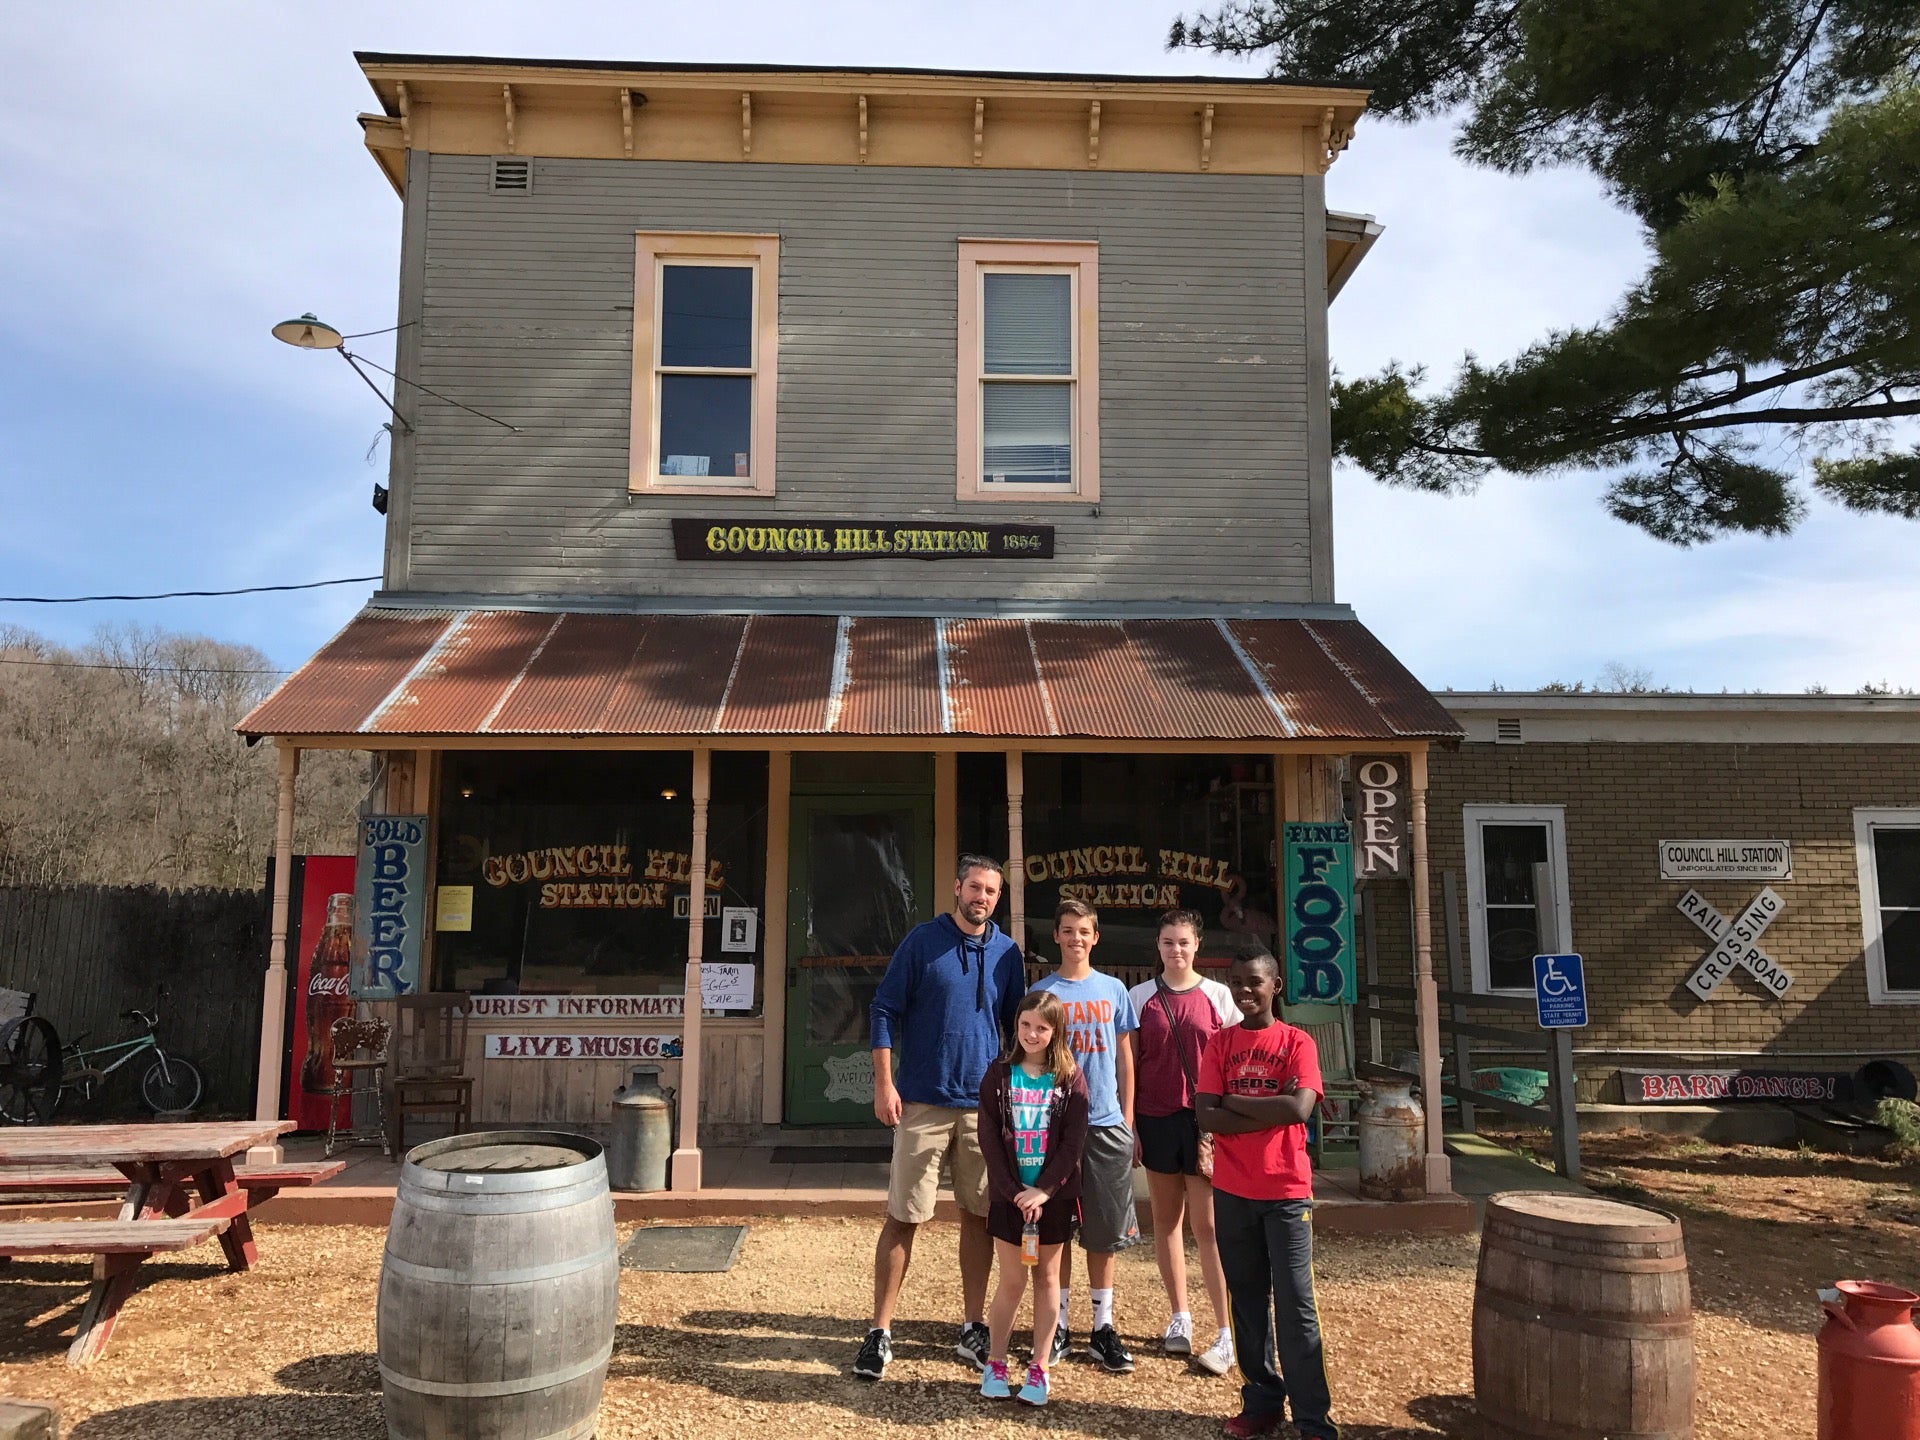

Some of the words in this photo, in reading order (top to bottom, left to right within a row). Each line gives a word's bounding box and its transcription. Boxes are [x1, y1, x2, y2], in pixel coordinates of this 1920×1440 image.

[706, 526, 831, 554] COUNCIL
[833, 528, 893, 554] HILL
[893, 529, 990, 555] STATION
[1002, 534, 1042, 551] 1854
[1359, 761, 1400, 872] OPEN
[365, 818, 423, 847] COLD
[1288, 825, 1350, 844] FINE
[482, 844, 633, 888] COUNCIL
[644, 848, 725, 891] HIL
[1667, 846, 1715, 863] COUNCIL
[1717, 847, 1739, 863] HILL
[1741, 847, 1783, 863] STATION
[1158, 848, 1235, 892] HILL
[1677, 865, 1735, 873] UNPOPULATED
[540, 882, 669, 909] STATION
[677, 897, 718, 916] ON
[1058, 883, 1180, 909] STATION
[368, 843, 413, 994] BEER
[1291, 846, 1347, 1001] FOOD
[1682, 894, 1722, 937] RAIL
[1743, 947, 1789, 991] ROAD
[1696, 896, 1777, 991] CROSSING
[308, 972, 349, 996] Coca-C
[461, 998, 548, 1016] OURIST
[1062, 999, 1112, 1026] TAND
[497, 1036, 573, 1057] LIVE
[577, 1036, 660, 1058] MUSIC
[1066, 1028, 1107, 1054] ALL
[1228, 1078, 1279, 1090] REDS
[1641, 1074, 1731, 1101] BARN
[1735, 1076, 1836, 1100] DANCE!
